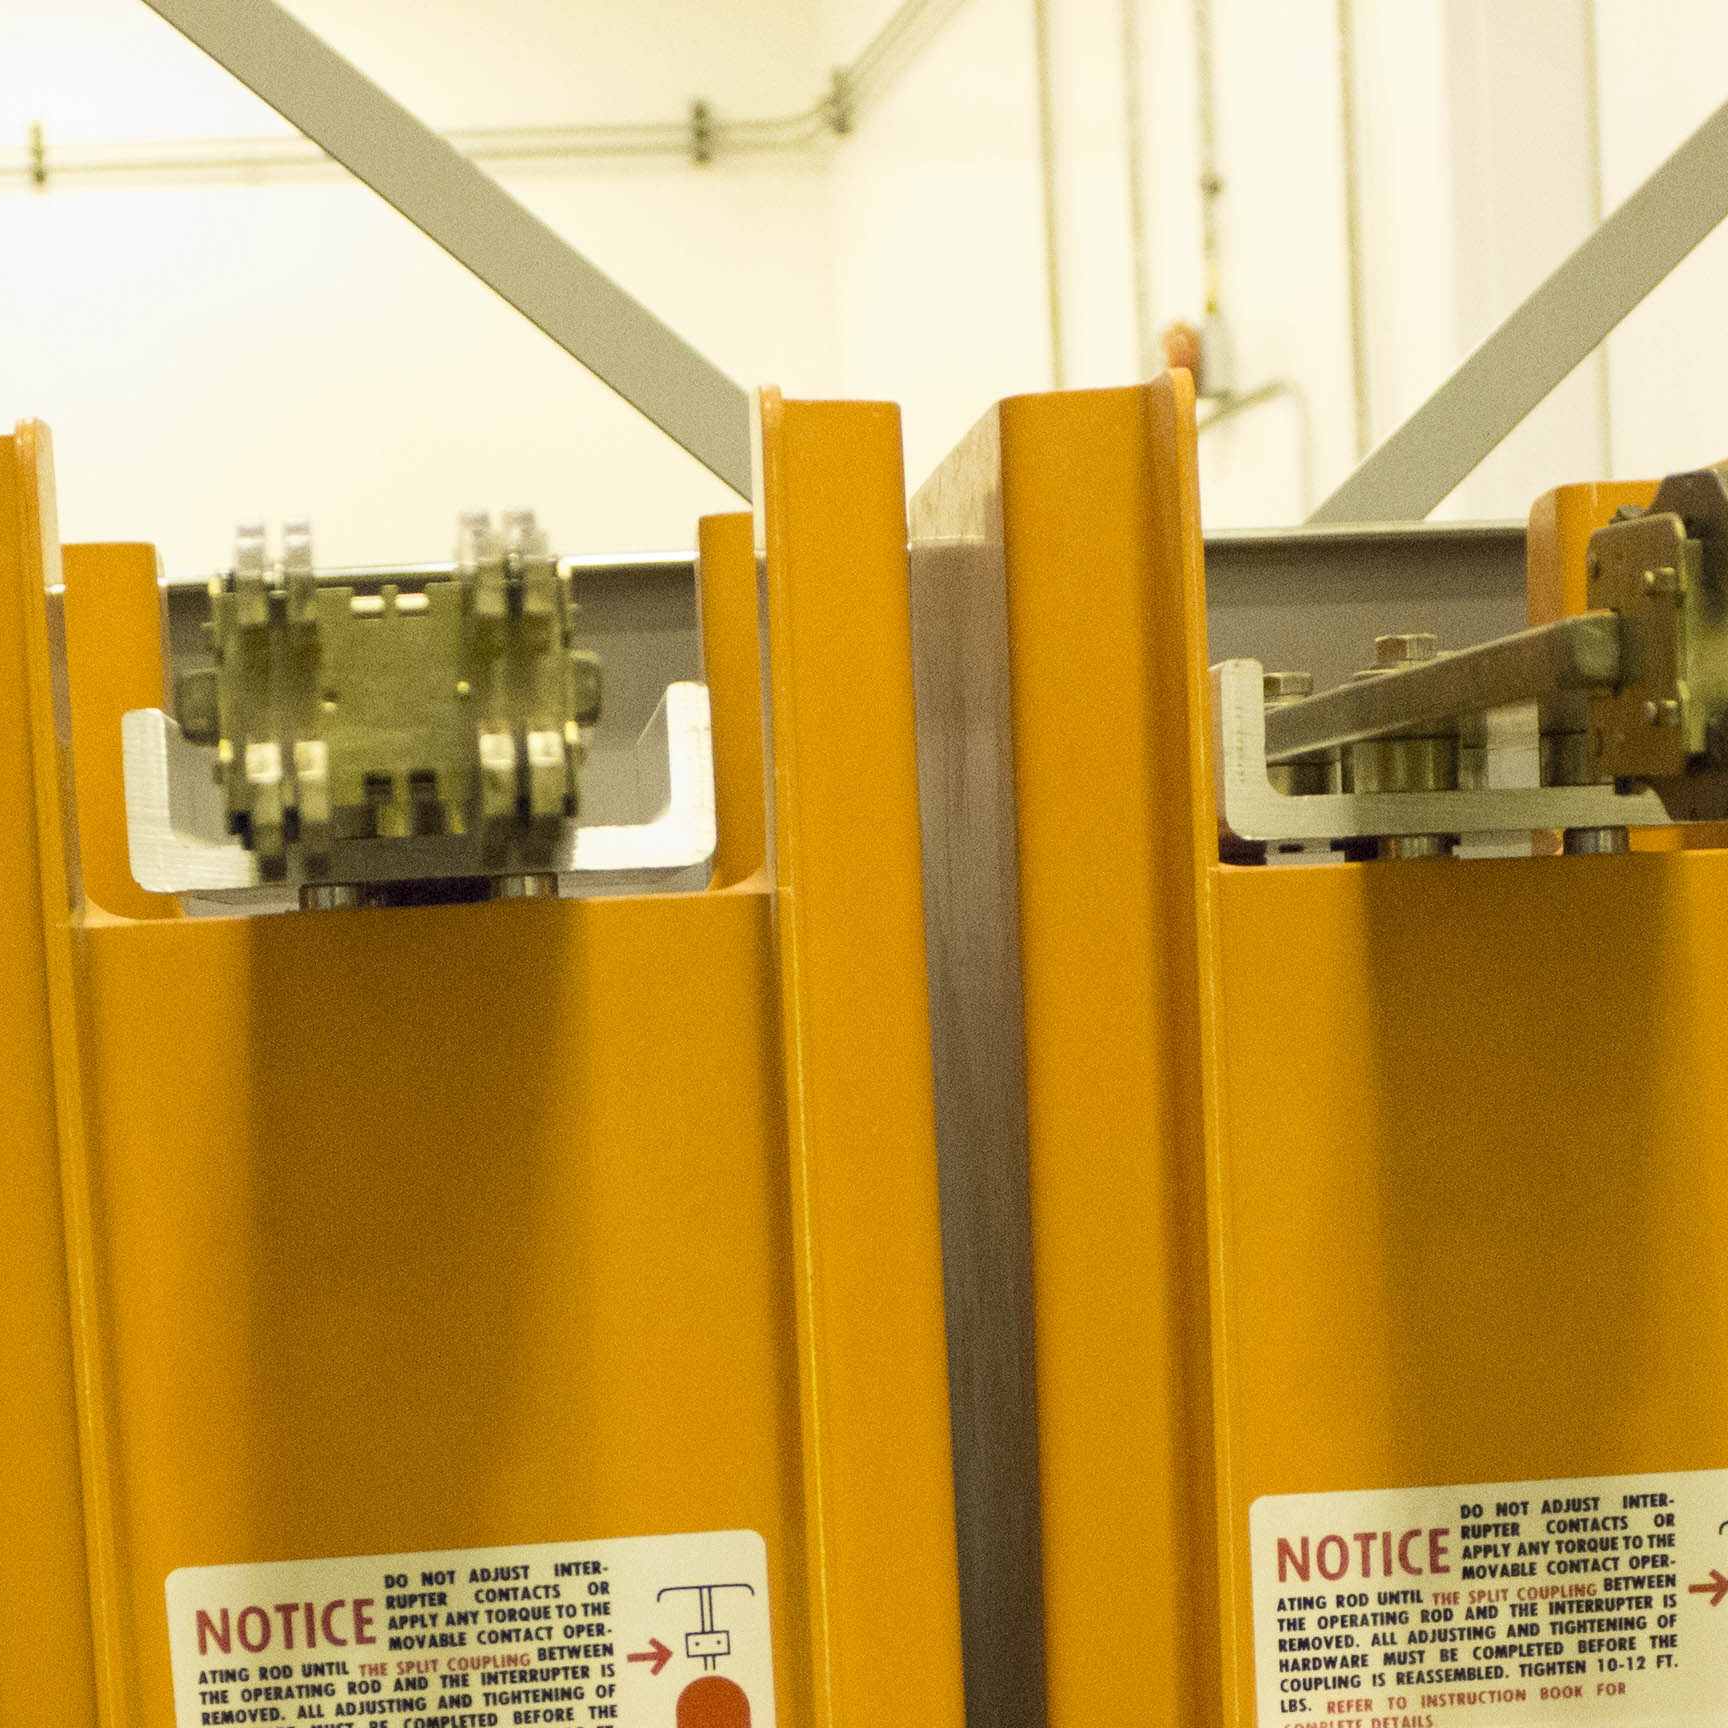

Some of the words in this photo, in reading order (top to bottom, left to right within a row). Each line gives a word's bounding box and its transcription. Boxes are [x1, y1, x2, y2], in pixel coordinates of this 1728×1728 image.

[1461, 1504, 1483, 1519] DO
[1496, 1501, 1529, 1517] NOT
[1541, 1497, 1600, 1514] ADJUST
[1623, 1492, 1675, 1509] INTER-
[1461, 1522, 1520, 1540] RUPTER
[1547, 1516, 1628, 1535] CONTACTS
[1654, 1513, 1675, 1528] OR
[1277, 1527, 1451, 1584] NOTICE
[1462, 1543, 1510, 1561] APPLY
[1517, 1541, 1550, 1557] ANY
[1555, 1537, 1619, 1555] TORQUE
[1623, 1535, 1643, 1551] TO
[1648, 1533, 1676, 1549] THE
[384, 1573, 408, 1590] DO
[421, 1570, 455, 1587] NOT
[468, 1565, 530, 1584] ADJUST
[554, 1560, 609, 1578] INTER-
[1462, 1562, 1537, 1580] MOVABLE
[1547, 1557, 1620, 1575] CONTACT
[1629, 1553, 1676, 1570] OPER-
[386, 1591, 448, 1610] RUPTER
[475, 1584, 560, 1604] CONTACTS
[588, 1581, 610, 1597] OR
[1277, 1596, 1327, 1613] ATING
[1336, 1593, 1369, 1609] ROD
[1377, 1590, 1423, 1606] UNTIL
[1432, 1591, 1460, 1607] THE
[1469, 1588, 1509, 1605] SPLIT
[1517, 1583, 1597, 1602] COUPLING
[1604, 1574, 1677, 1592] BETWEEN
[195, 1597, 376, 1657] NOTICE
[388, 1613, 438, 1631] APPLY
[446, 1610, 478, 1627] ANY
[486, 1605, 551, 1624] TORQUE
[556, 1604, 577, 1619] TO
[582, 1601, 610, 1618] THE
[1278, 1617, 1306, 1633] THE
[1318, 1611, 1409, 1630] OPERATING
[1421, 1608, 1454, 1624] ROD
[1465, 1605, 1499, 1621] AND
[1509, 1603, 1538, 1618] THE
[1549, 1596, 1653, 1616] INTERRUPTER
[1663, 1594, 1677, 1609] IS
[389, 1632, 466, 1651] MOVABLE
[477, 1626, 553, 1645] CONTACT
[563, 1622, 612, 1639] OPER-
[1278, 1634, 1360, 1653] REMOVED.
[1371, 1632, 1398, 1647] ALL
[1408, 1626, 1496, 1645] ADJUSTING
[1507, 1623, 1540, 1639] AND
[1550, 1616, 1647, 1636] TIGHTENING
[1657, 1614, 1677, 1629] OF
[198, 1668, 250, 1685] ATING
[259, 1665, 293, 1681] ROD
[302, 1661, 349, 1678] UNTIL
[359, 1662, 388, 1678] THE
[396, 1659, 438, 1676] SPLIT
[447, 1652, 531, 1672] COUPLING
[537, 1643, 614, 1663] BETWEEN
[1279, 1654, 1369, 1673] HARDWARE
[1384, 1650, 1425, 1667] MUST
[1440, 1648, 1458, 1663] BE
[1473, 1642, 1564, 1661] COMPLETED
[1577, 1637, 1636, 1655] BEFORE
[1650, 1635, 1678, 1650] THE
[199, 1689, 229, 1706] THE
[241, 1682, 336, 1703] OPERATING
[348, 1679, 382, 1696] ROD
[393, 1676, 428, 1693] AND
[440, 1673, 469, 1690] THE
[481, 1665, 590, 1687] INTERRUPTER
[601, 1663, 615, 1679] IS
[1280, 1674, 1362, 1693] COUPLING
[1372, 1673, 1385, 1687] IS
[1396, 1665, 1509, 1686] REASSEMBLED.
[1519, 1660, 1586, 1678] TIGHTEN
[1598, 1657, 1646, 1673] 10-12
[1656, 1655, 1678, 1670] FT.
[202, 1706, 285, 1726] REMOVED.
[297, 1704, 325, 1720] ALL
[336, 1697, 427, 1717] ADJUSTING
[438, 1694, 472, 1711] AND
[483, 1686, 584, 1707] TIGHTENING
[595, 1684, 616, 1700] OF
[513, 1707, 574, 1726] BEFORE
[588, 1704, 618, 1721] THE
[1280, 1698, 1312, 1714] LBS.
[1327, 1698, 1373, 1714] REFER
[1387, 1696, 1407, 1710] TO
[1421, 1688, 1527, 1708] INSTRUCTION
[1540, 1685, 1583, 1701] BOOK
[1597, 1682, 1627, 1697] FOR
